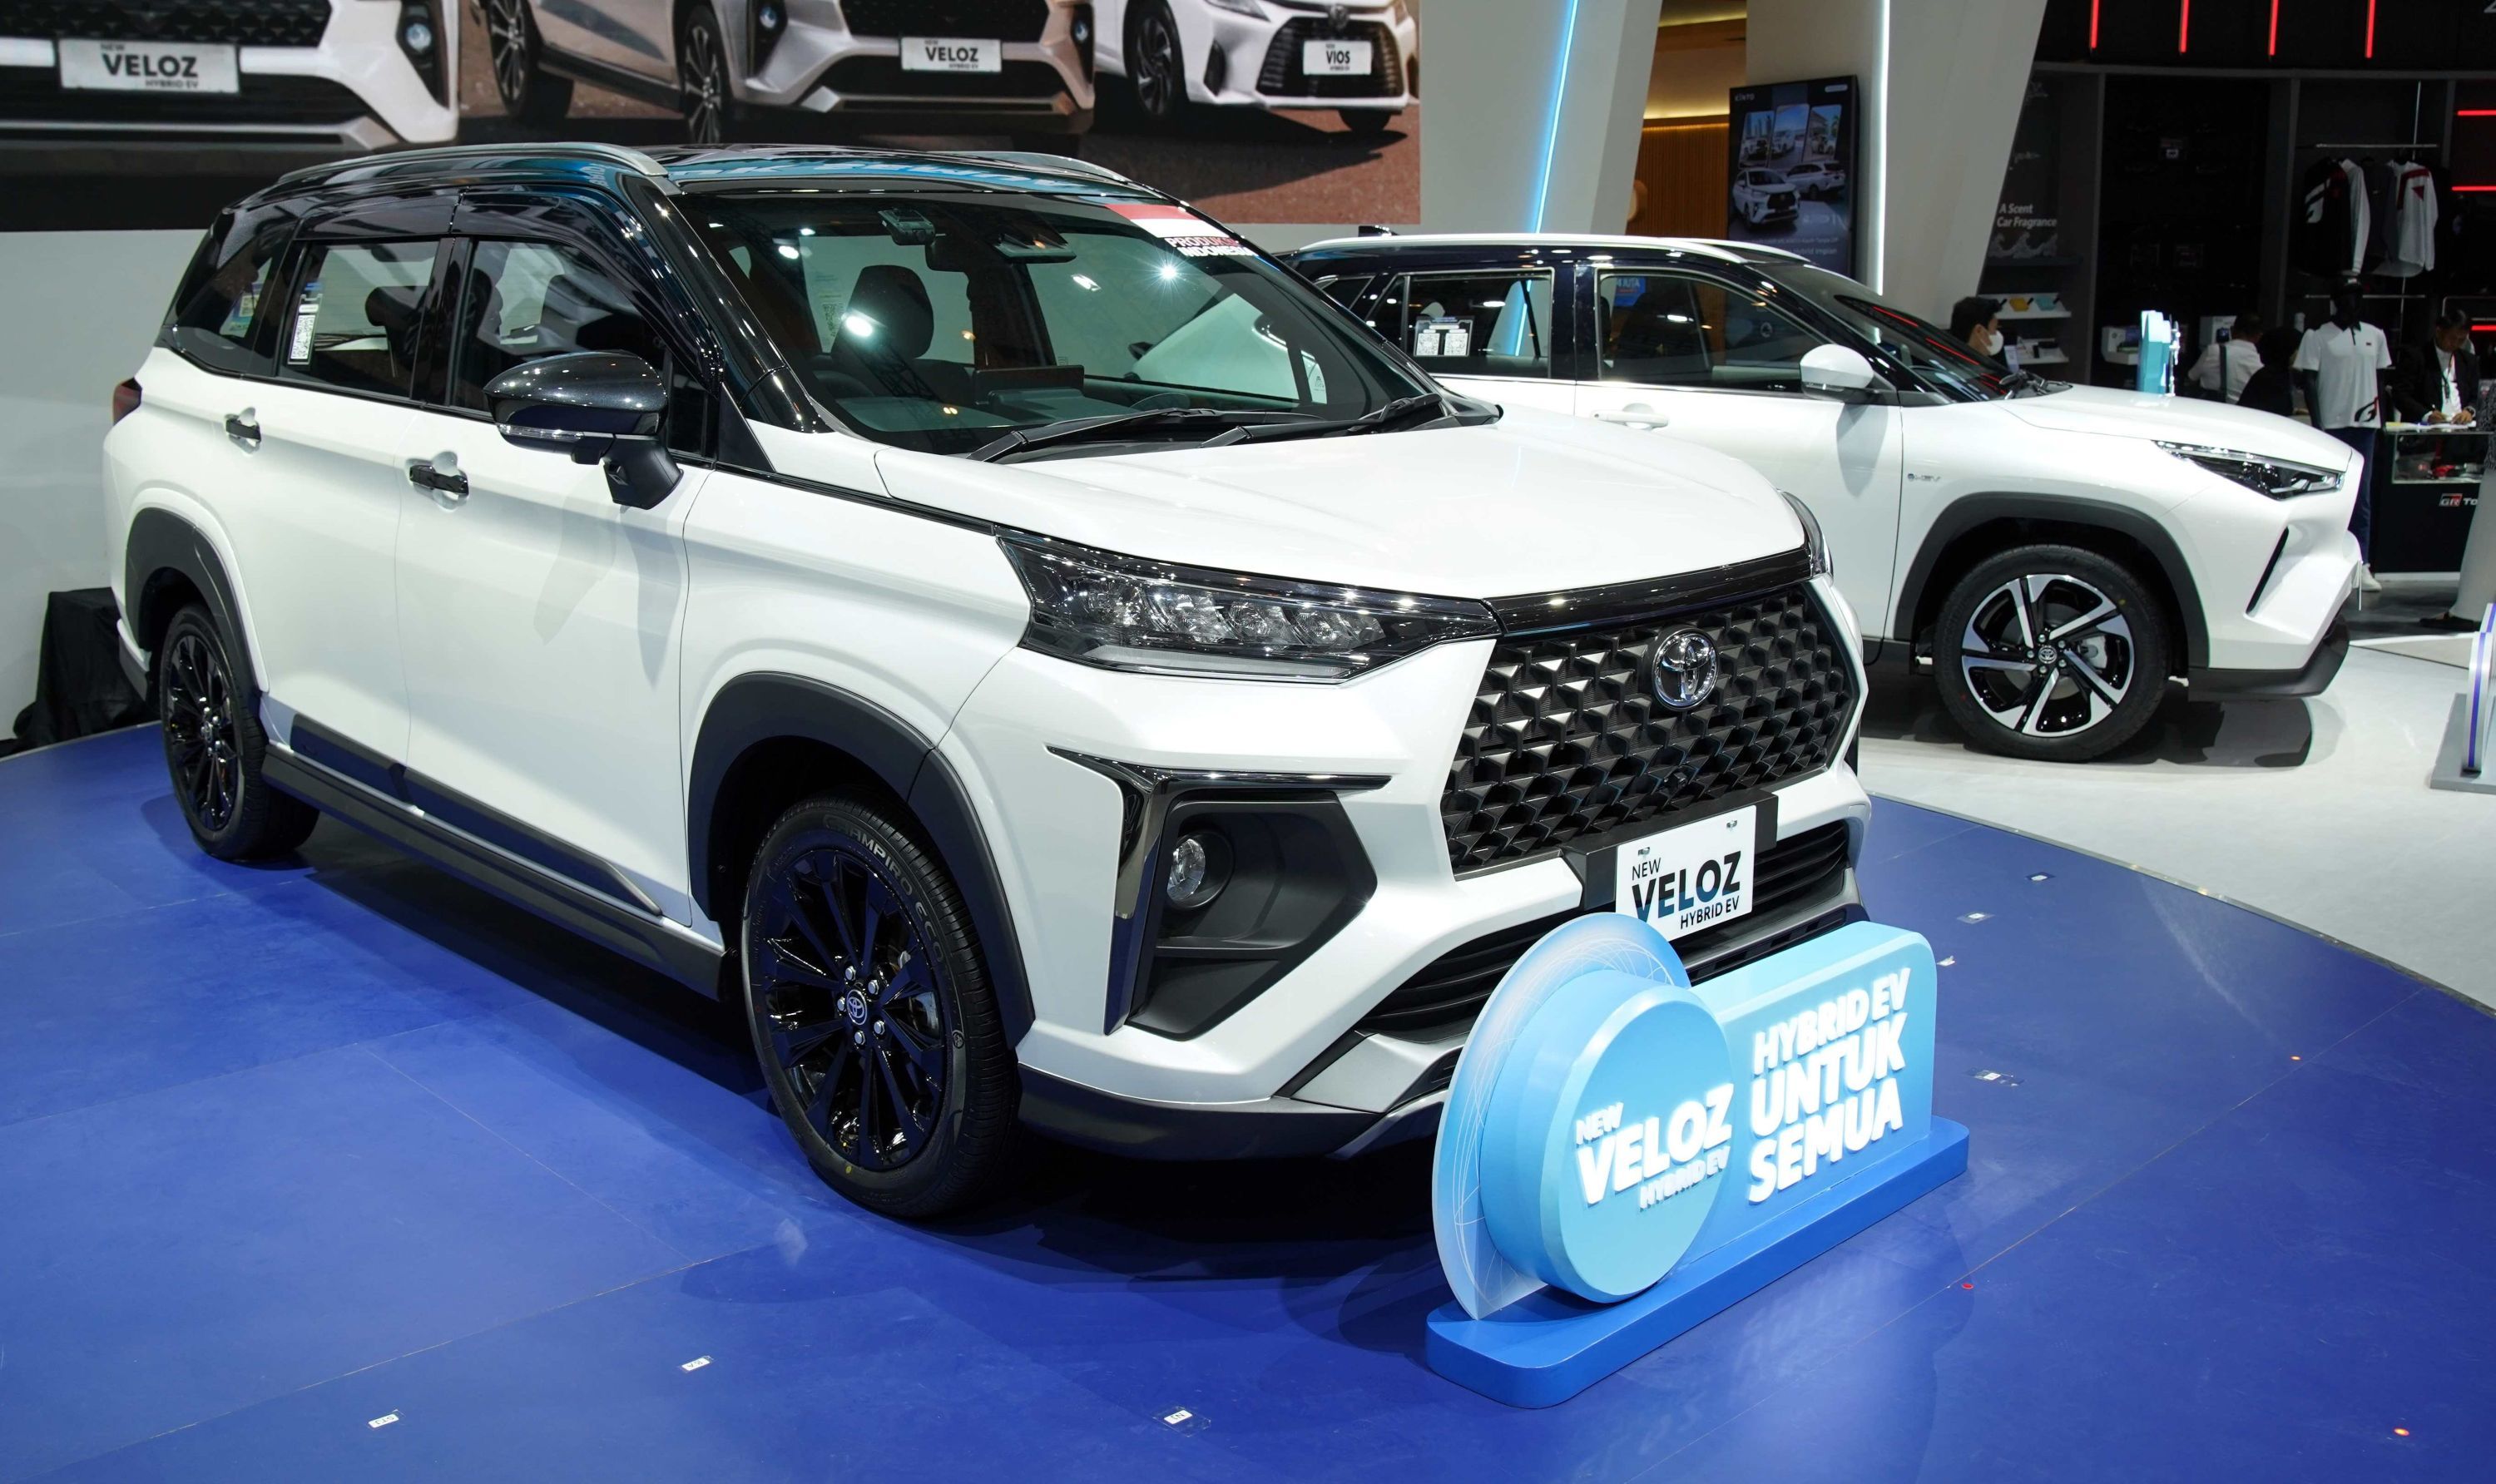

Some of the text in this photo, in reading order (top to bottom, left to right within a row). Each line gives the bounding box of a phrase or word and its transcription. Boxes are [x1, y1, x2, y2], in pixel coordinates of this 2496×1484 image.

[102, 53, 198, 77] VELOZ
[925, 47, 978, 62] VELOZ
[1326, 51, 1350, 64] VIOS
[145, 80, 184, 88] HYBRID
[1997, 216, 2058, 230] Car Fragrance
[1999, 203, 2033, 214] A Scent
[2439, 496, 2479, 507] GR TO
[1632, 858, 1662, 880] NEW
[1632, 850, 1741, 923] VELOZ
[1681, 895, 1740, 929] HYBRID EV
[1754, 967, 1911, 1076] HYBRID EV
[1751, 1012, 1908, 1136] UNTUK
[1576, 1102, 1624, 1145] NEW
[1577, 1083, 1735, 1205] VELOZ
[1748, 1077, 1904, 1203] SEMUA
[1640, 1145, 1731, 1209] HYBRID EV
